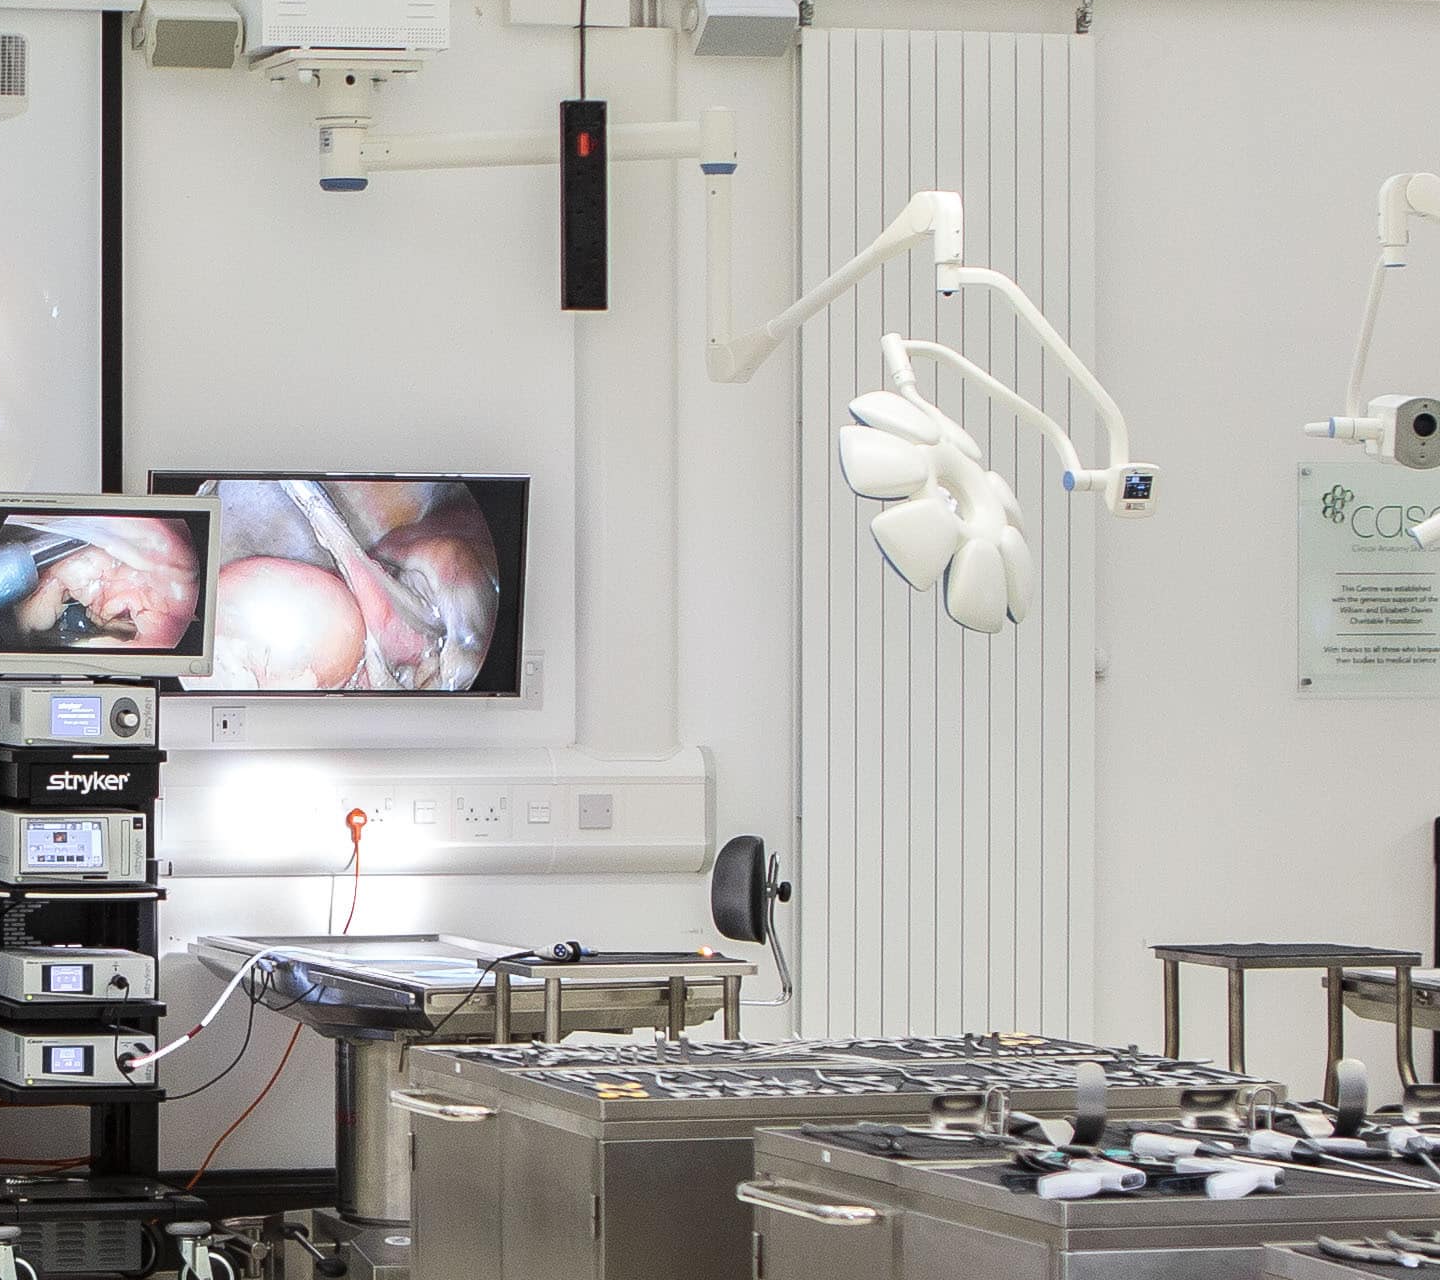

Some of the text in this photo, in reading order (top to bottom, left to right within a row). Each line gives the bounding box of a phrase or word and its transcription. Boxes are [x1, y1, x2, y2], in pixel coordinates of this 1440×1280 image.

[1356, 585, 1378, 593] Centre
[1380, 585, 1392, 593] was
[46, 771, 130, 795] stryker
